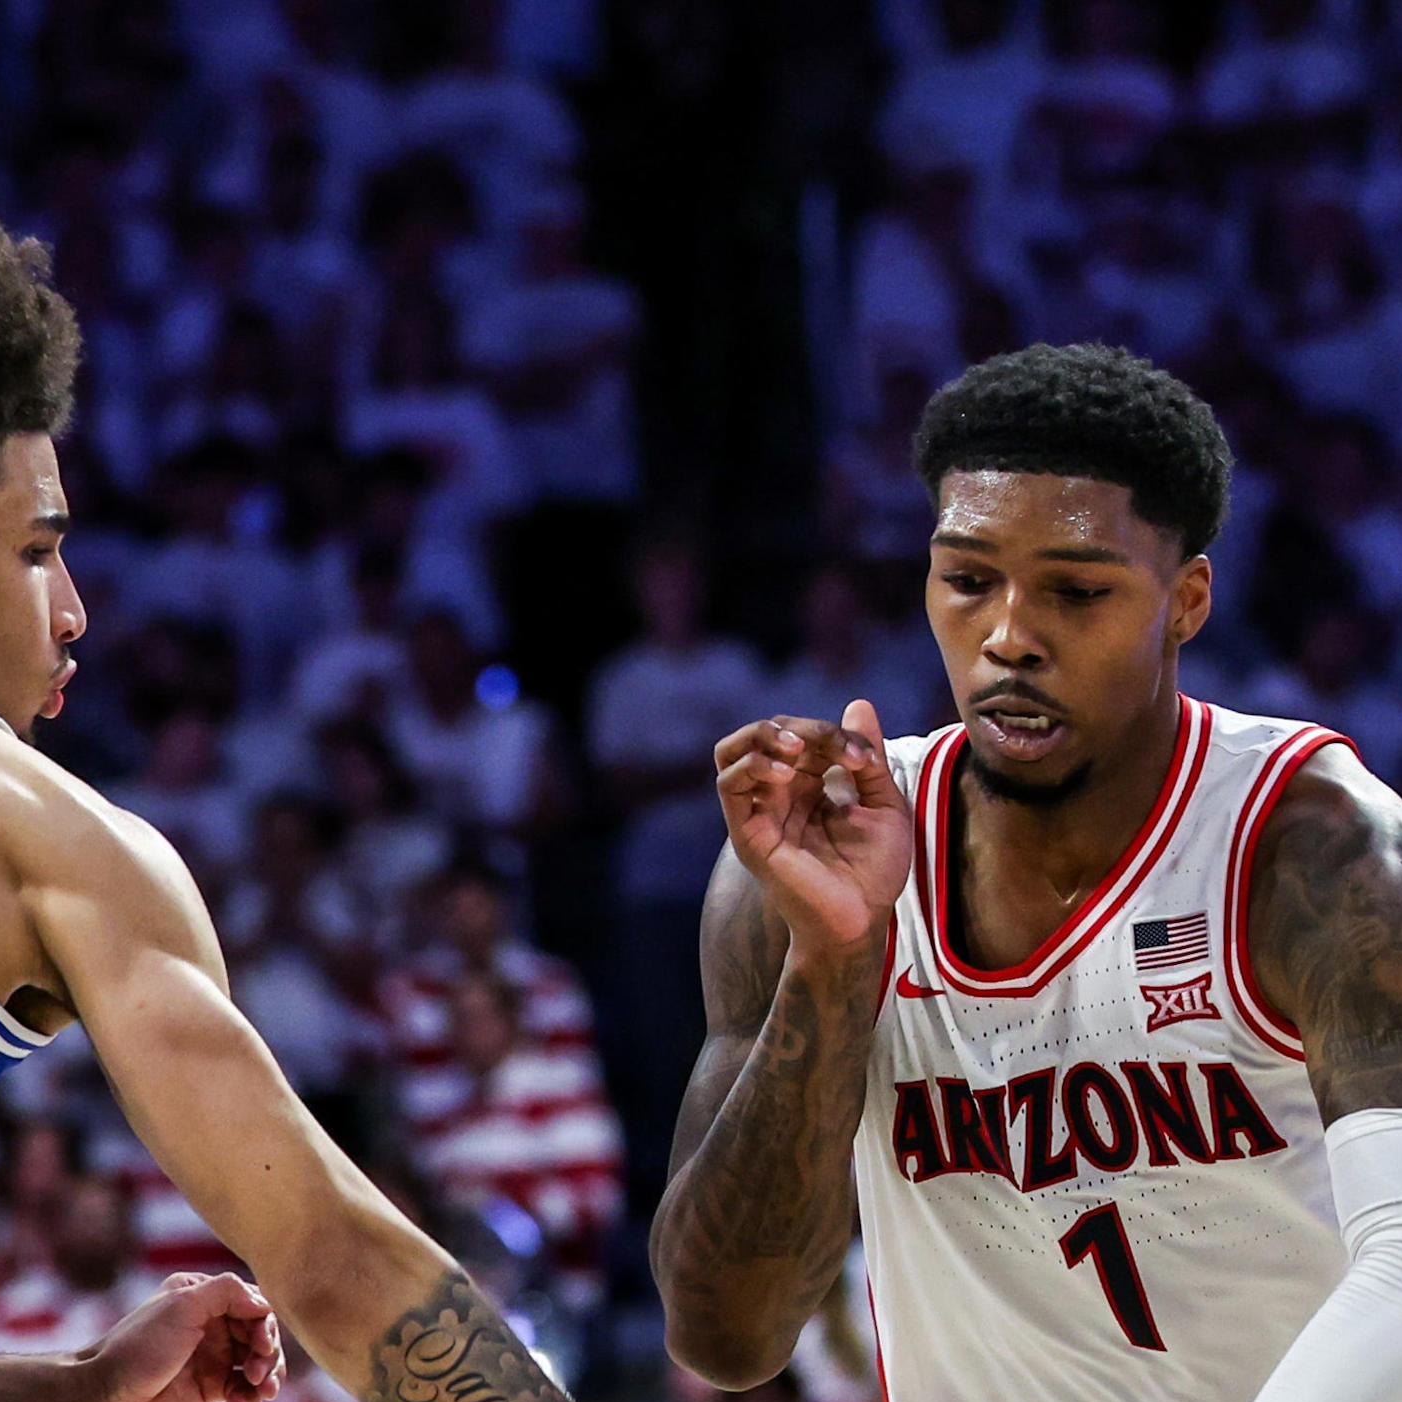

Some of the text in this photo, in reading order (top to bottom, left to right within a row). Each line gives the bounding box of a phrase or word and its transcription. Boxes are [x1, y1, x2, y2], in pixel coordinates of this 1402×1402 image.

[1145, 978, 1215, 1027] XII
[892, 1060, 1288, 1193] ARIZONA
[1058, 1201, 1168, 1352] 1
